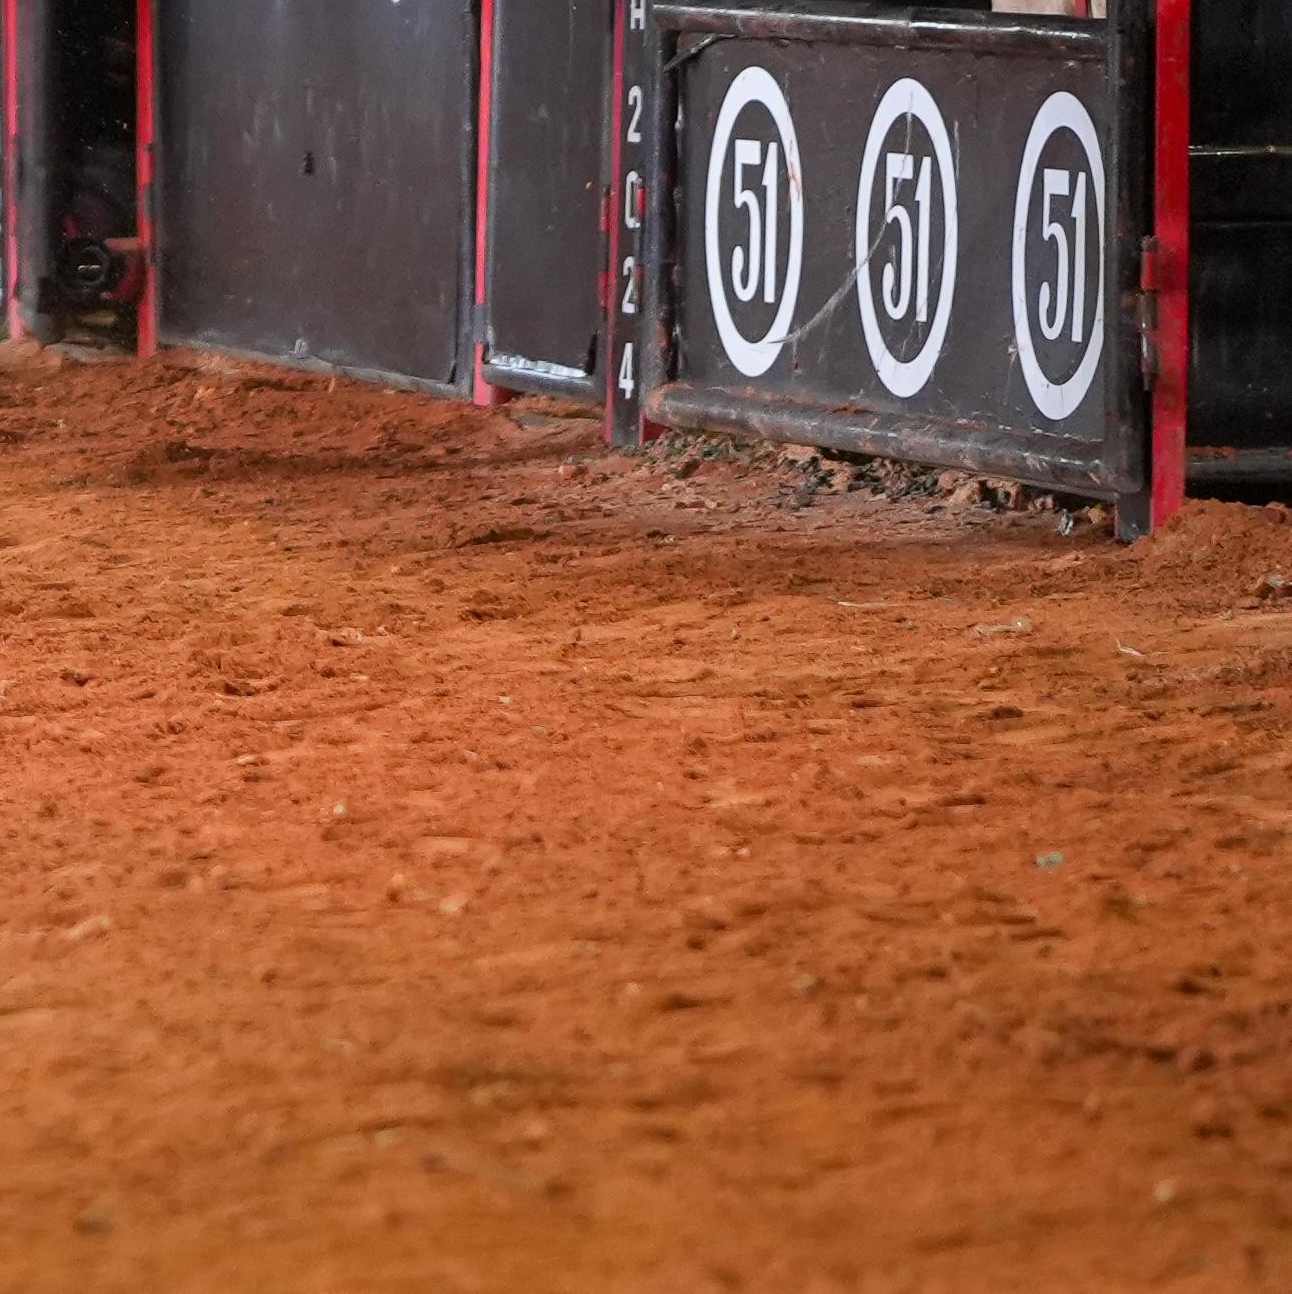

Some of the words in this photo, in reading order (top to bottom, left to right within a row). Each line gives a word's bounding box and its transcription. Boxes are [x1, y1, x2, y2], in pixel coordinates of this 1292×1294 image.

[618, 85, 643, 400] 2024
[732, 139, 778, 303] 51
[883, 153, 932, 322] 51
[1039, 168, 1087, 343] 51
